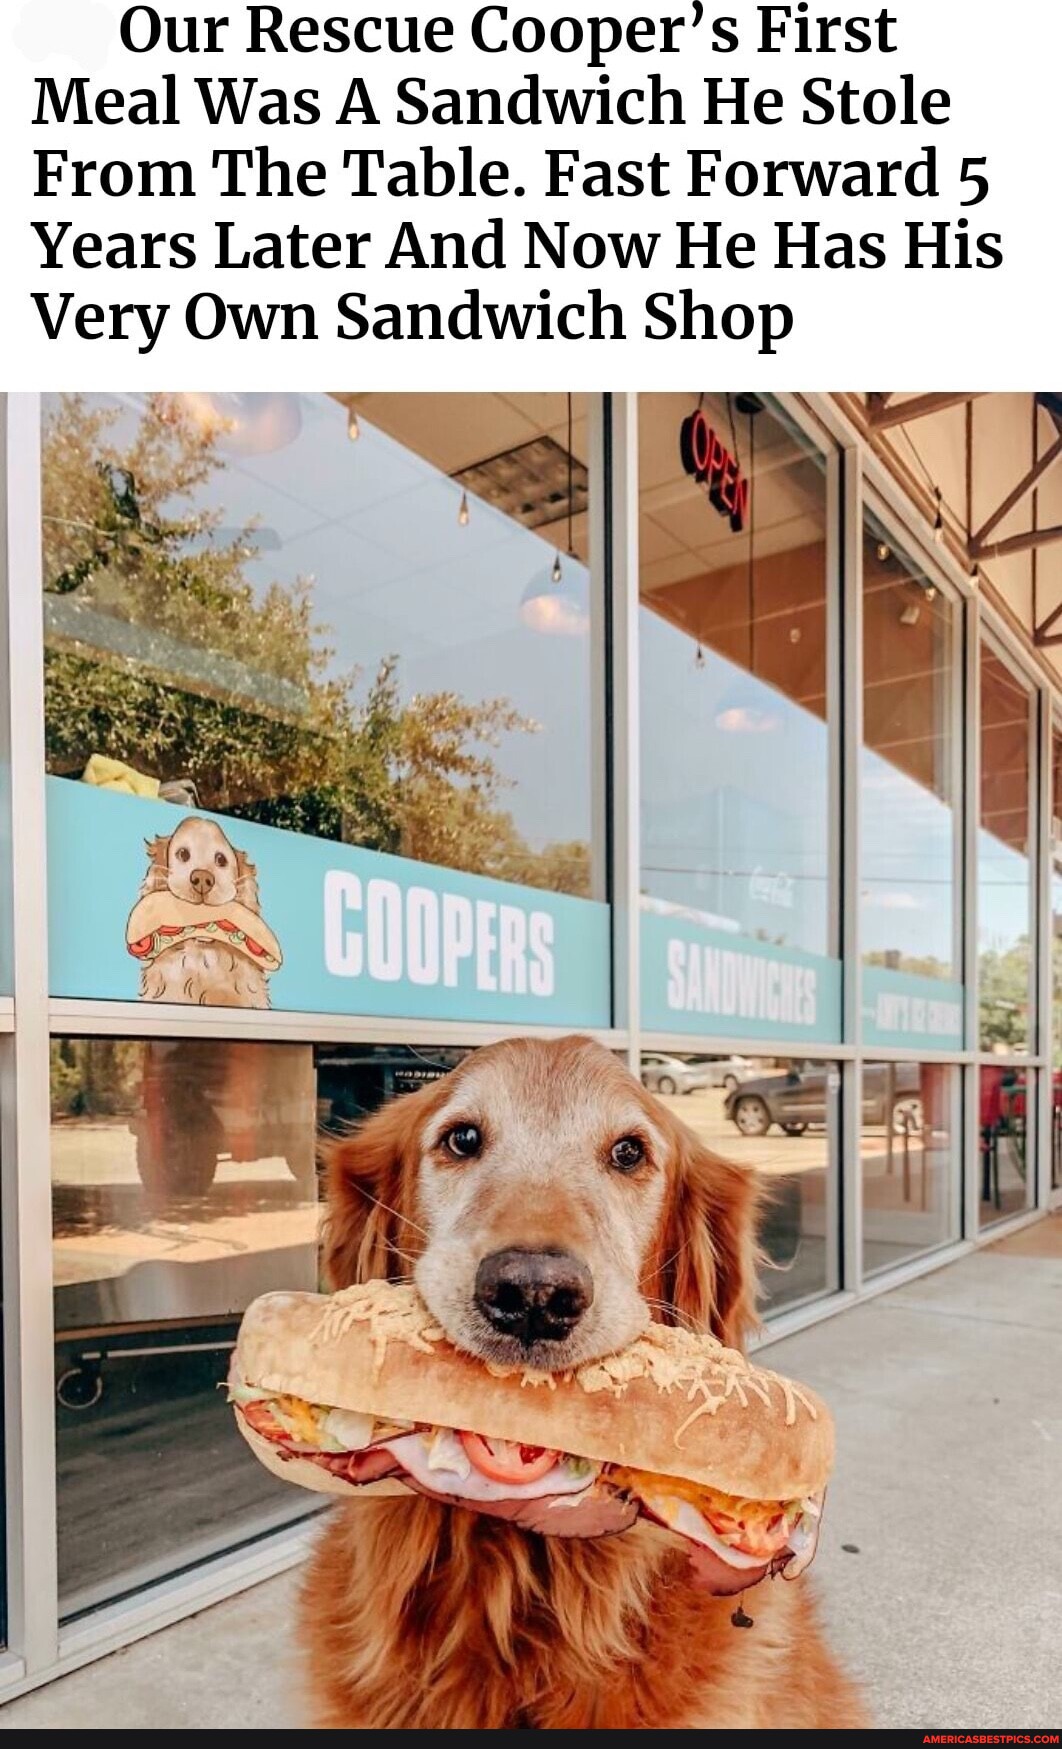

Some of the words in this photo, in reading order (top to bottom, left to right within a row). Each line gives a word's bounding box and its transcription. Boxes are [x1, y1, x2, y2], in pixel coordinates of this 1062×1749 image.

[690, 411, 750, 525] OPEN
[324, 869, 555, 997] COOPERS
[667, 938, 817, 1026] SANDWICHES
